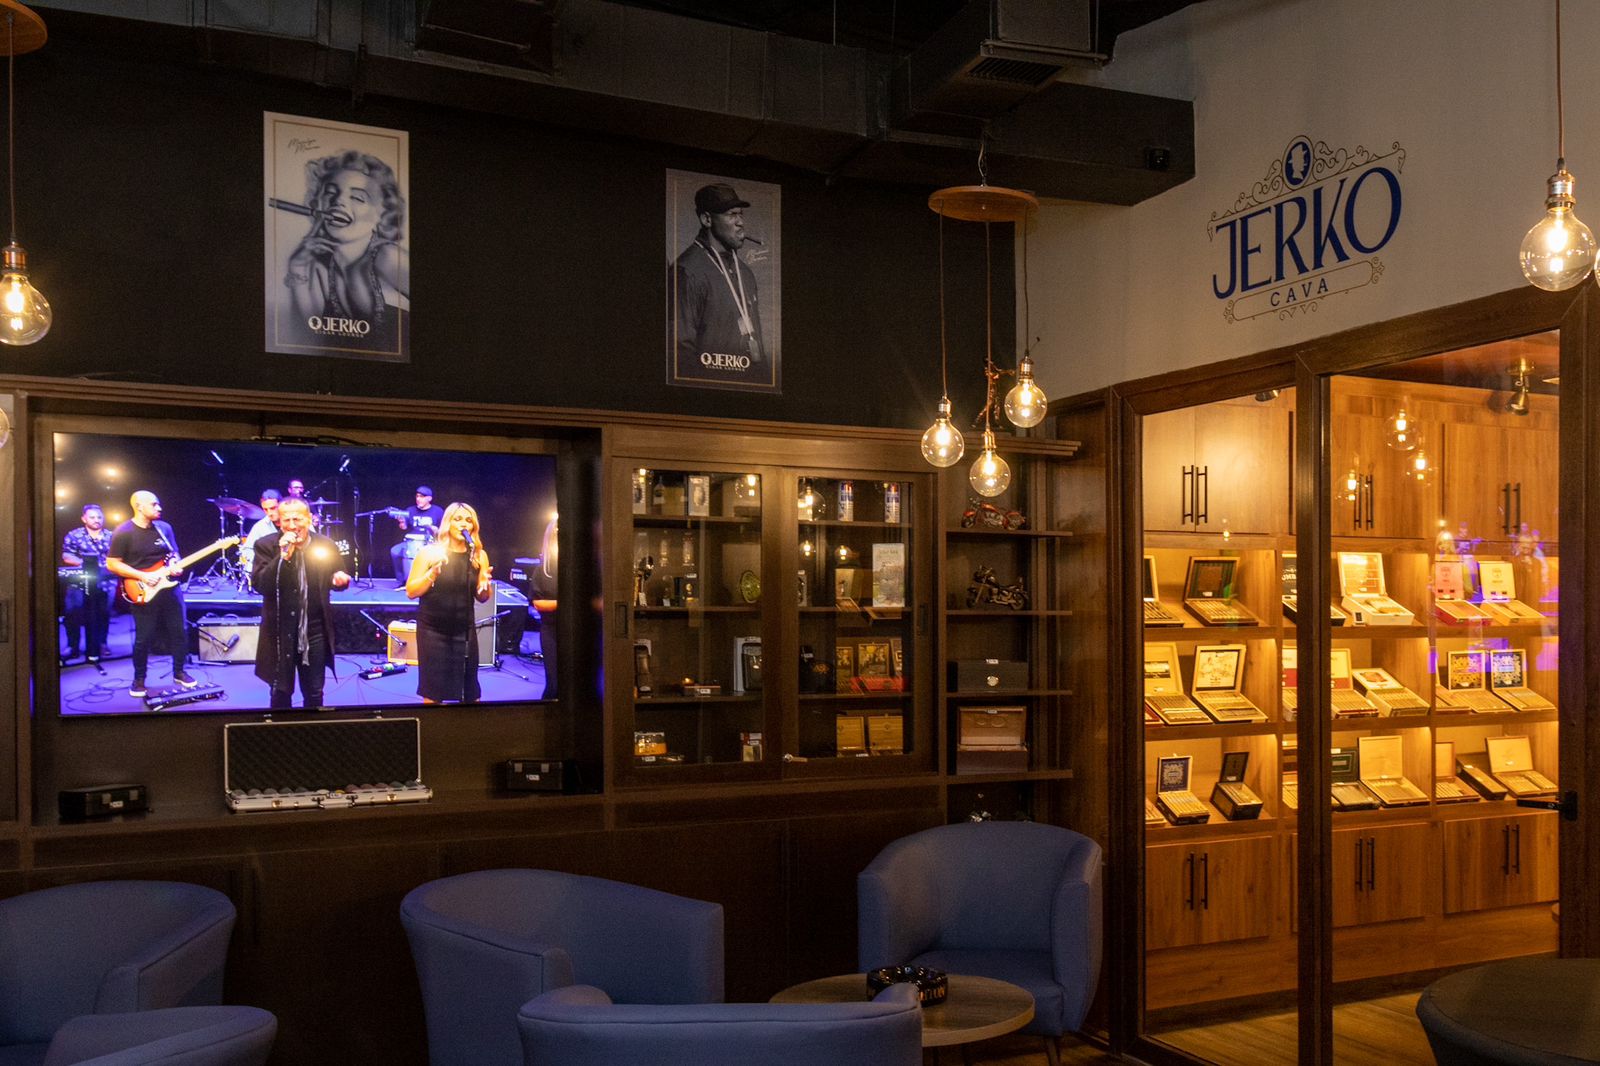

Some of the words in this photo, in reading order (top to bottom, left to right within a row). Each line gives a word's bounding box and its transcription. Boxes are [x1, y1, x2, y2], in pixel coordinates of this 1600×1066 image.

[1212, 167, 1402, 299] JERKO
[1270, 278, 1329, 307] CAVA
[322, 316, 370, 334] JERKO
[712, 353, 750, 369] JERKO
